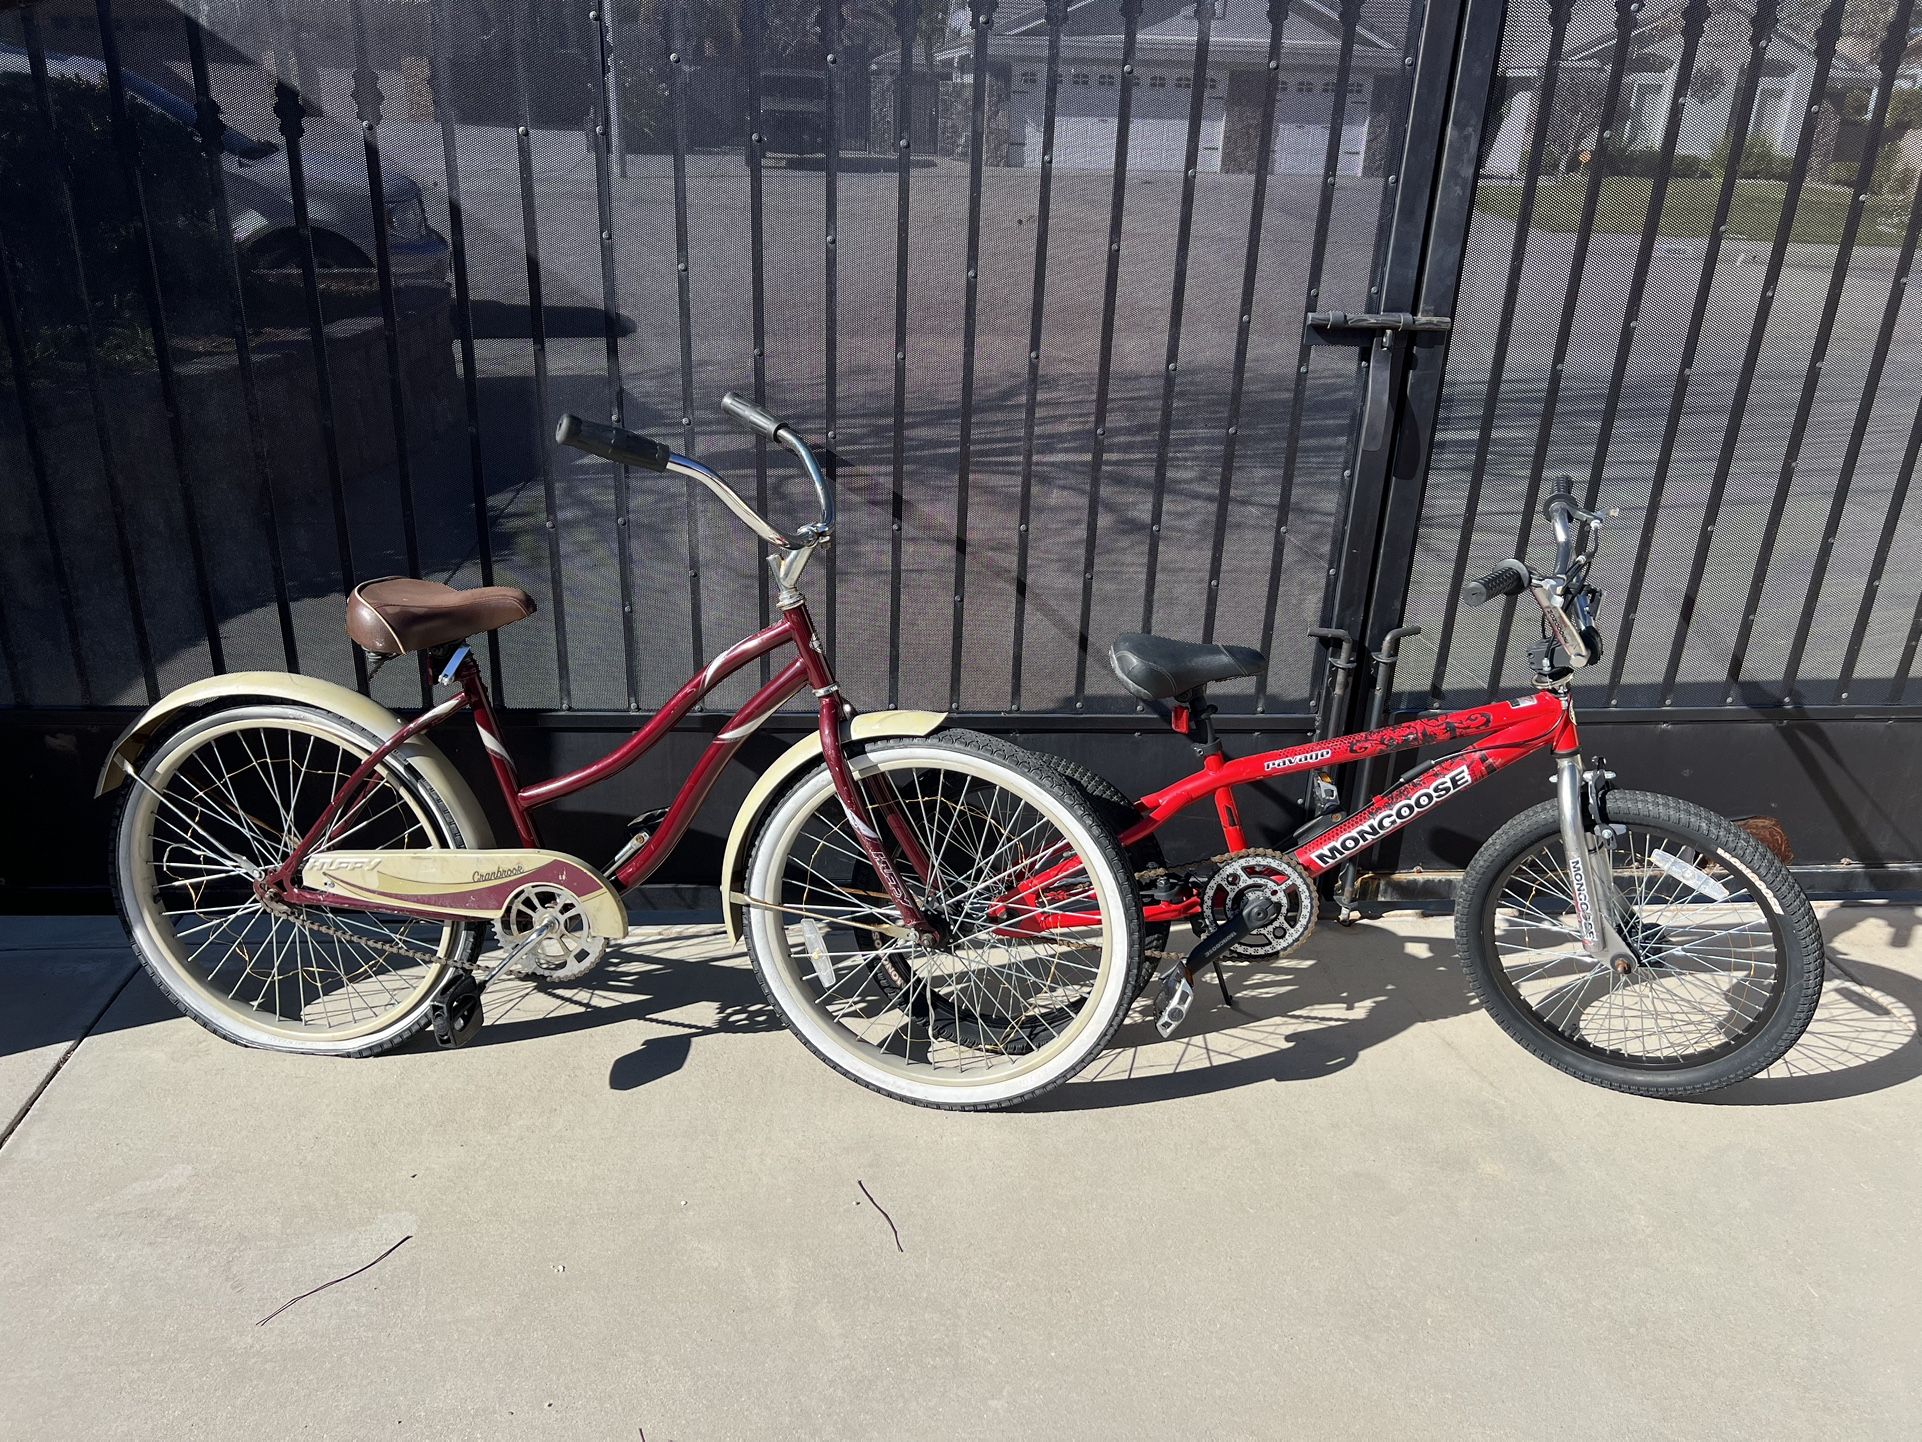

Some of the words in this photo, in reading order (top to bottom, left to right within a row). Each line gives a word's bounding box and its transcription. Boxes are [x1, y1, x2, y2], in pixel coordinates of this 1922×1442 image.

[1313, 766, 1471, 866] MONGOOSE
[307, 858, 382, 872] HUFFY
[472, 865, 524, 883] Cranbrook
[871, 851, 913, 907] HUFFY
[1716, 847, 1784, 915] MONGOOSE
